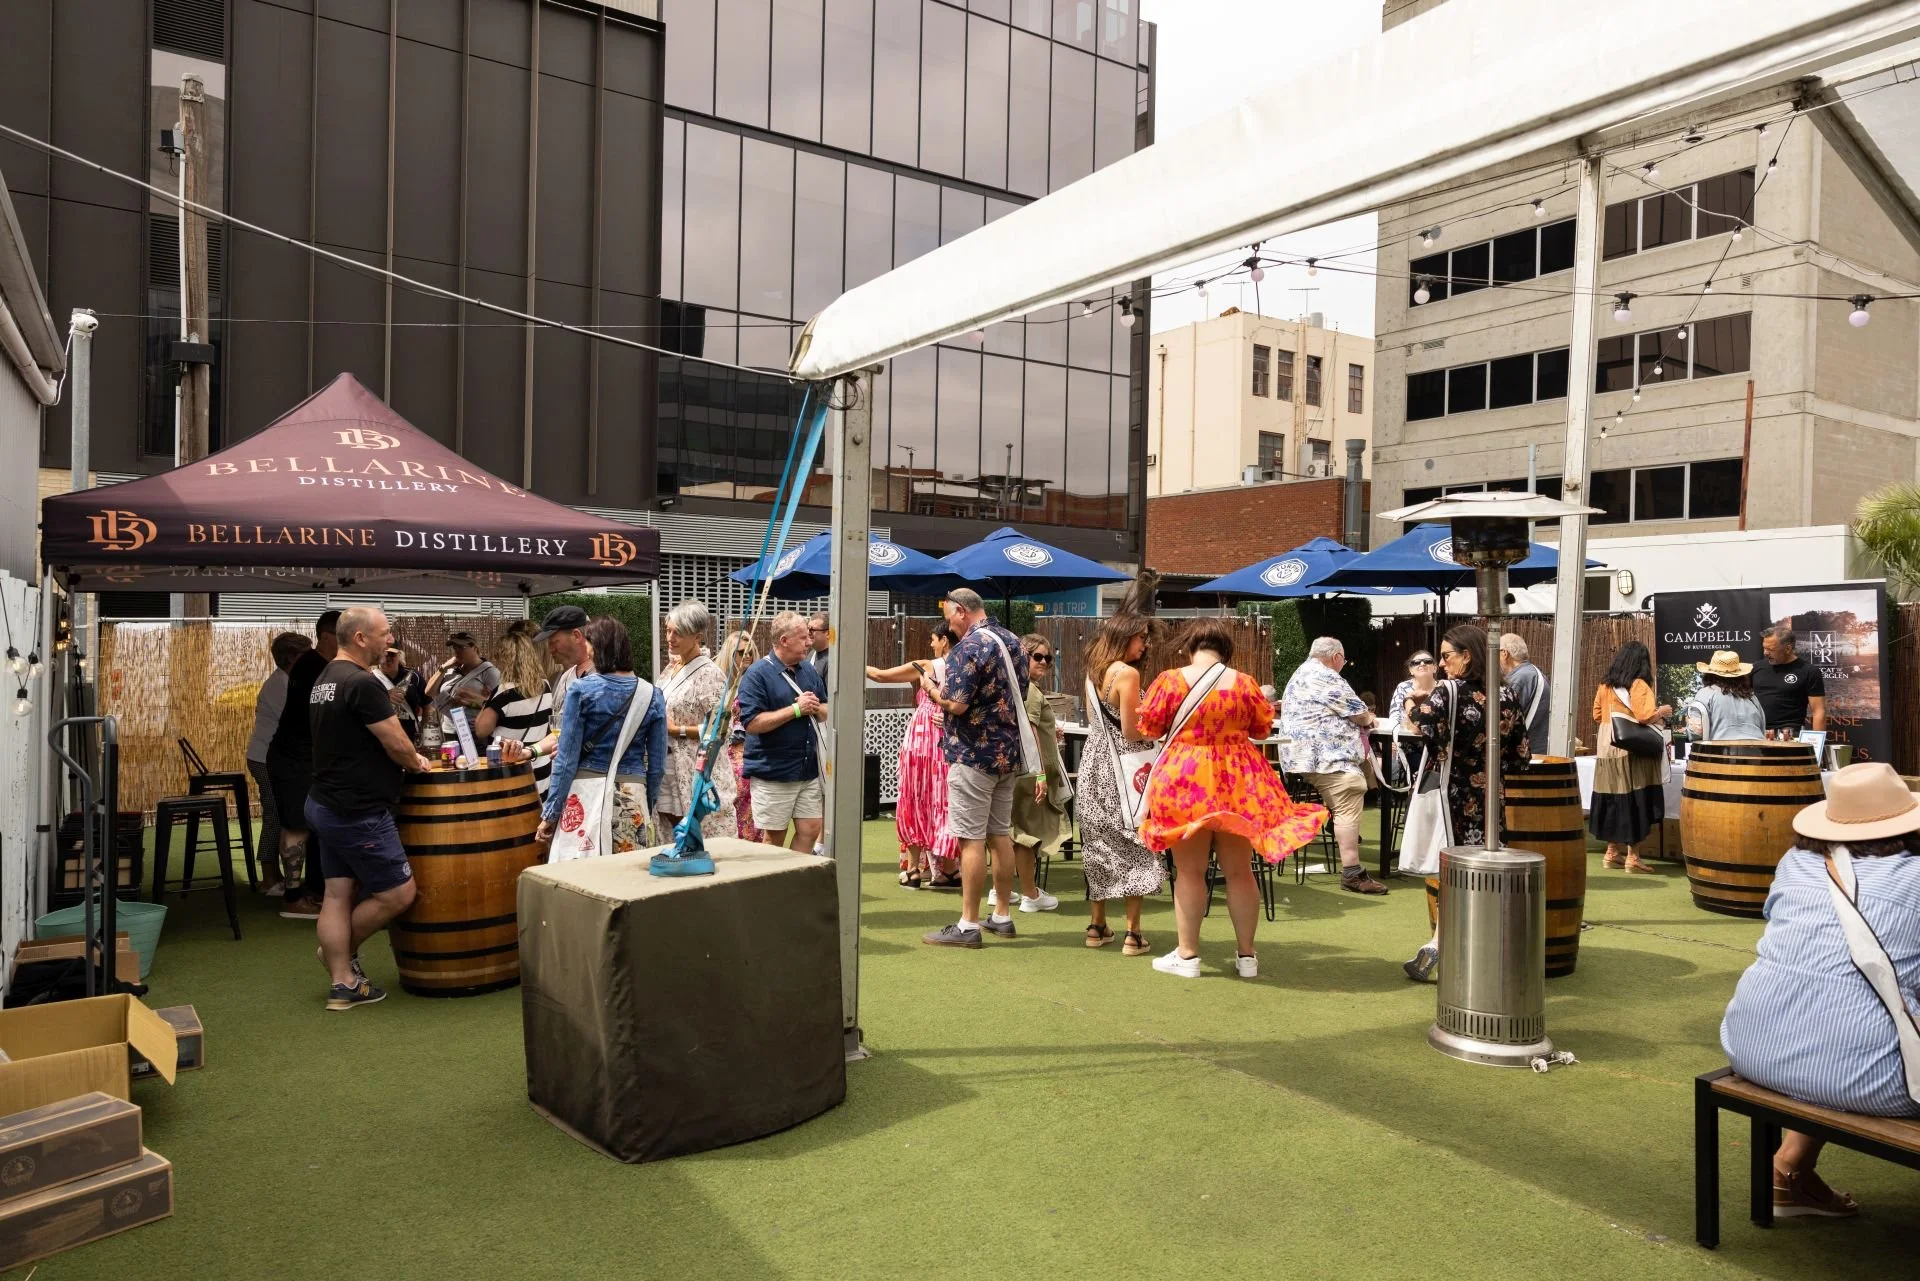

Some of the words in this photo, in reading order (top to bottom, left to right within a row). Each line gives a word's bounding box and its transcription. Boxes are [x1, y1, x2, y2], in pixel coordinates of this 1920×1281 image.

[206, 456, 526, 498] BELLARINE
[299, 476, 460, 493] DISTILLERY
[187, 523, 376, 547] BELLARINE
[394, 530, 568, 556] DISTILLERY
[1067, 601, 1087, 613] TRIP
[1664, 630, 1752, 644] CAMPBELLS
